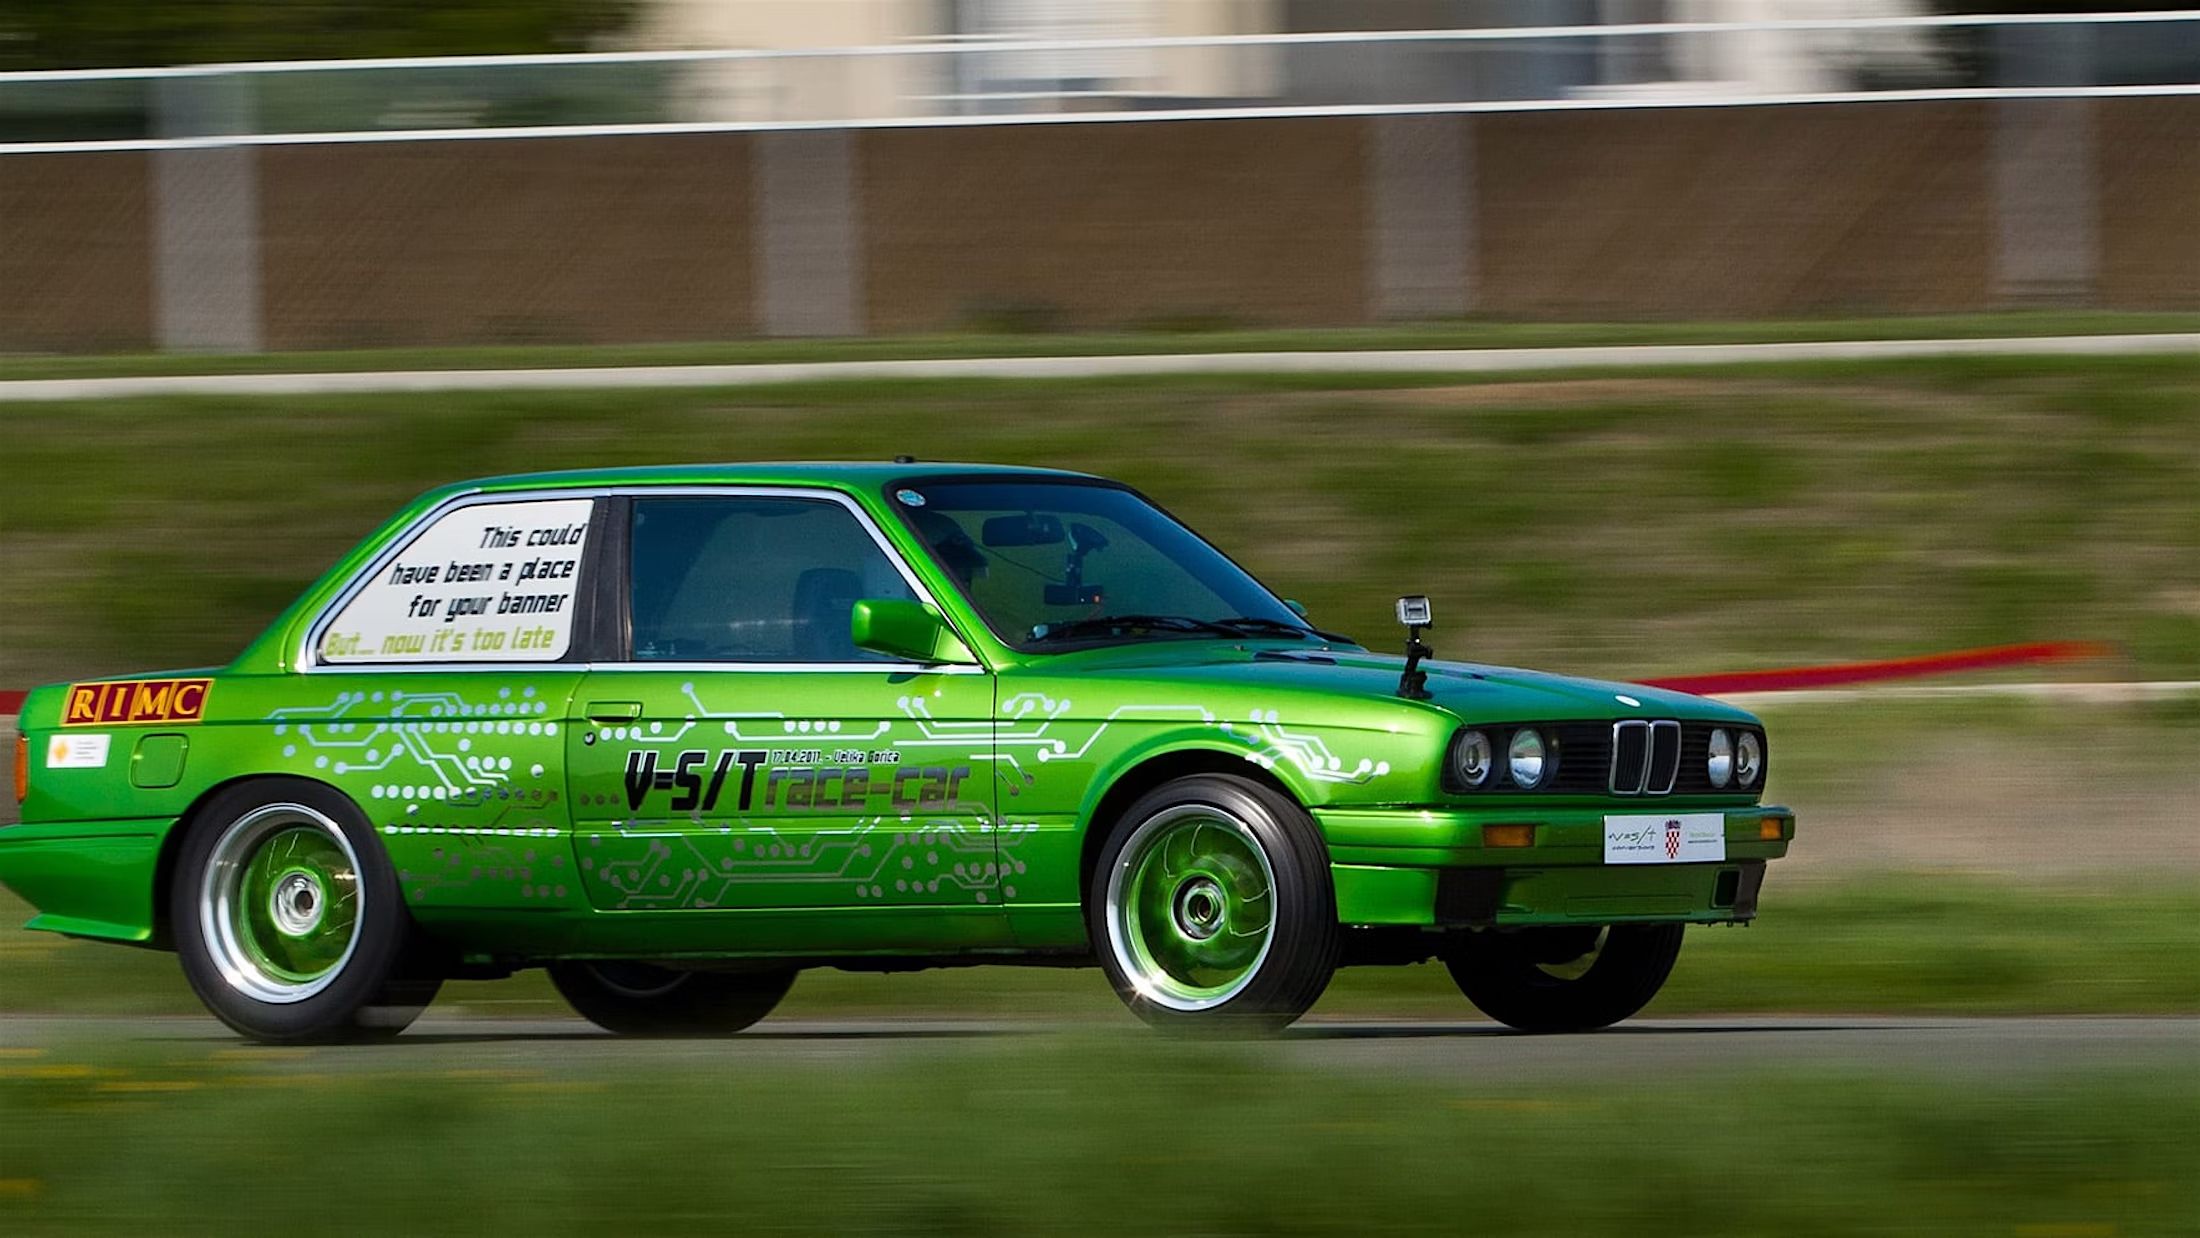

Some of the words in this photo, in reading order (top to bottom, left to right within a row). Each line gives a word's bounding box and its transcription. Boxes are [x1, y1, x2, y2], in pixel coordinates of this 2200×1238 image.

[480, 526, 522, 549] This
[527, 523, 587, 548] could
[389, 562, 440, 585] have
[443, 560, 494, 584] been
[499, 562, 515, 581] a
[516, 557, 576, 586] place
[408, 595, 440, 618] for
[444, 597, 493, 623] your
[497, 593, 568, 615] banner
[381, 636, 425, 655] now
[430, 627, 464, 653] it's
[472, 629, 502, 650] too
[510, 626, 555, 650] late
[70, 685, 204, 718] RIMC
[834, 750, 866, 764] Velika
[868, 750, 900, 764] Gorica
[764, 767, 970, 811] race-car
